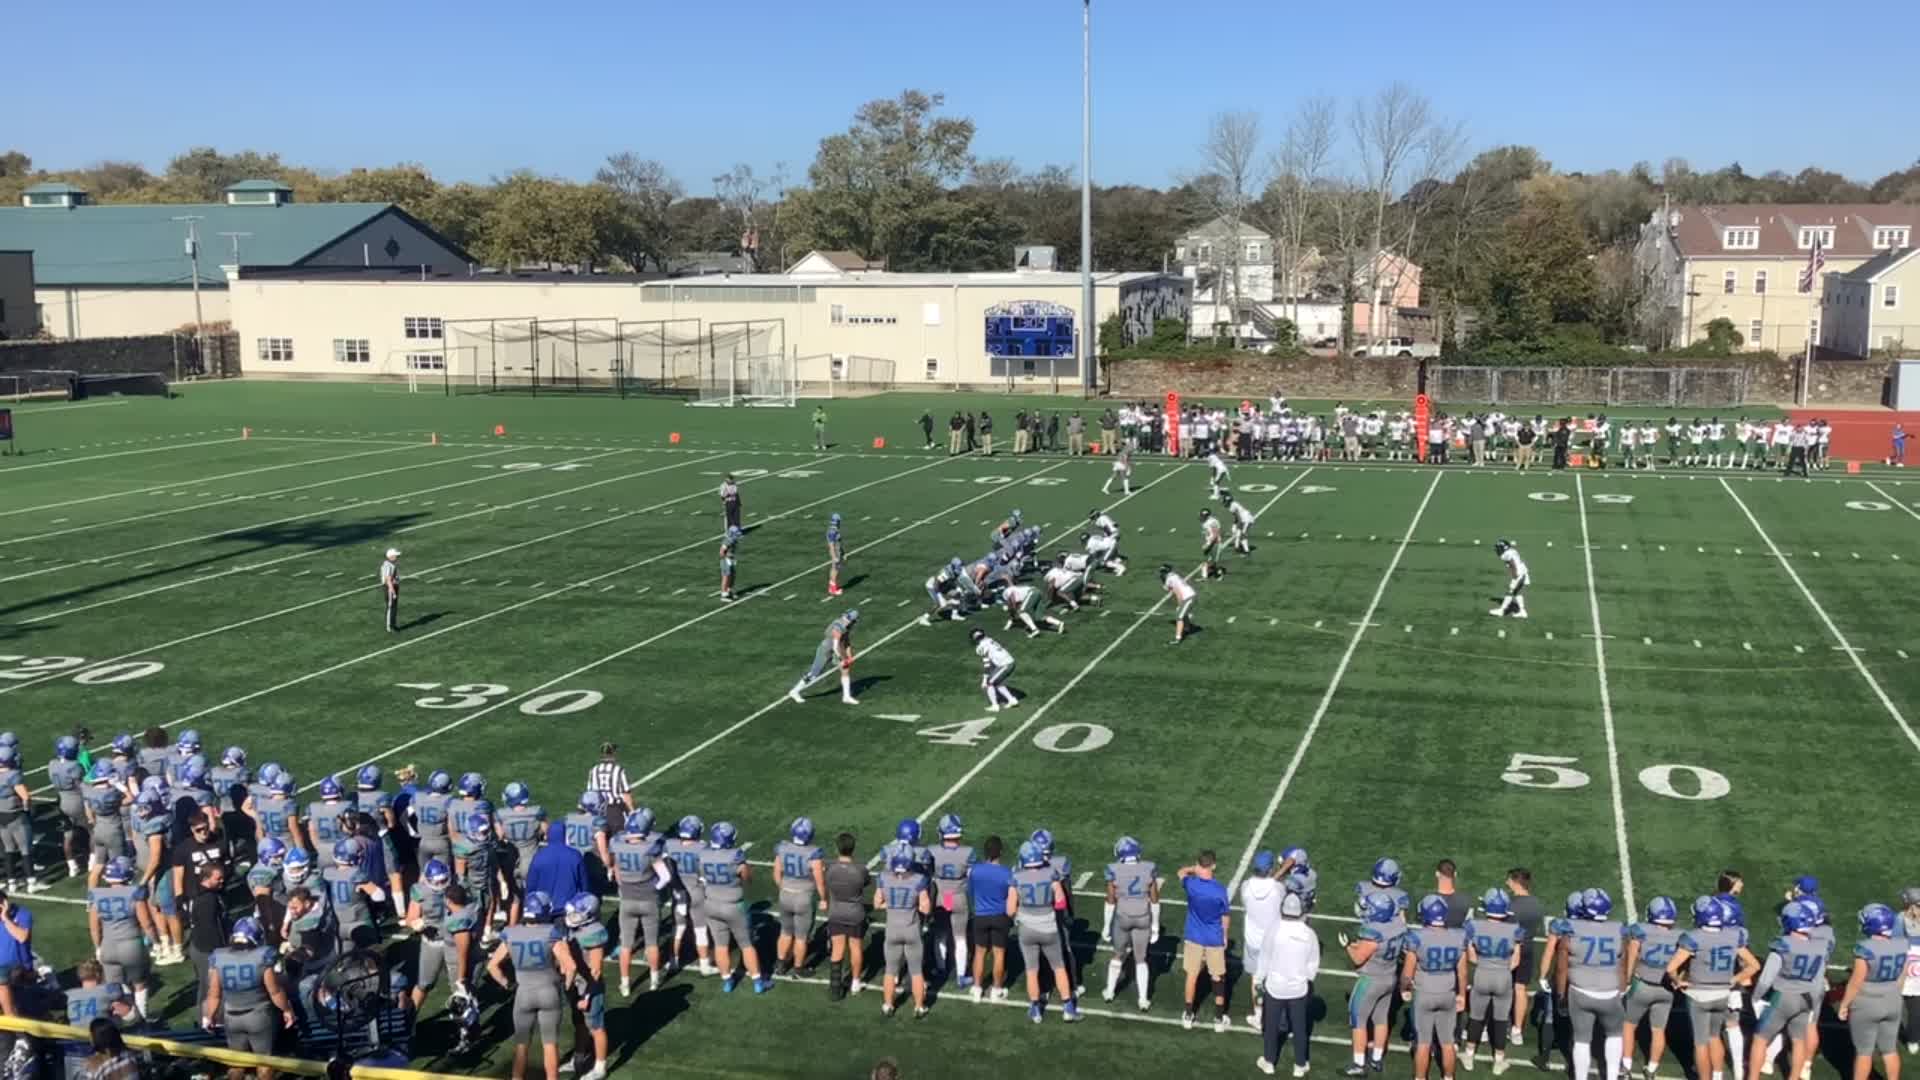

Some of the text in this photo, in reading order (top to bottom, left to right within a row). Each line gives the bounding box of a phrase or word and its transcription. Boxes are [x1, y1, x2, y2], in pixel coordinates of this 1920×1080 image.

[415, 683, 603, 715] 30
[916, 717, 1114, 752] 40
[1501, 753, 1730, 800] 50
[510, 820, 529, 841] 17
[704, 863, 730, 884] 55
[784, 853, 804, 879] 61
[889, 886, 911, 908] 17
[1020, 881, 1050, 904] 37
[1127, 877, 1143, 896] 2
[512, 941, 545, 969] 79
[1427, 946, 1459, 970] 89
[1477, 935, 1509, 959] 84
[1580, 936, 1617, 965] 75
[1709, 946, 1733, 972] 15
[222, 964, 256, 992] 69
[1792, 954, 1822, 980] 94
